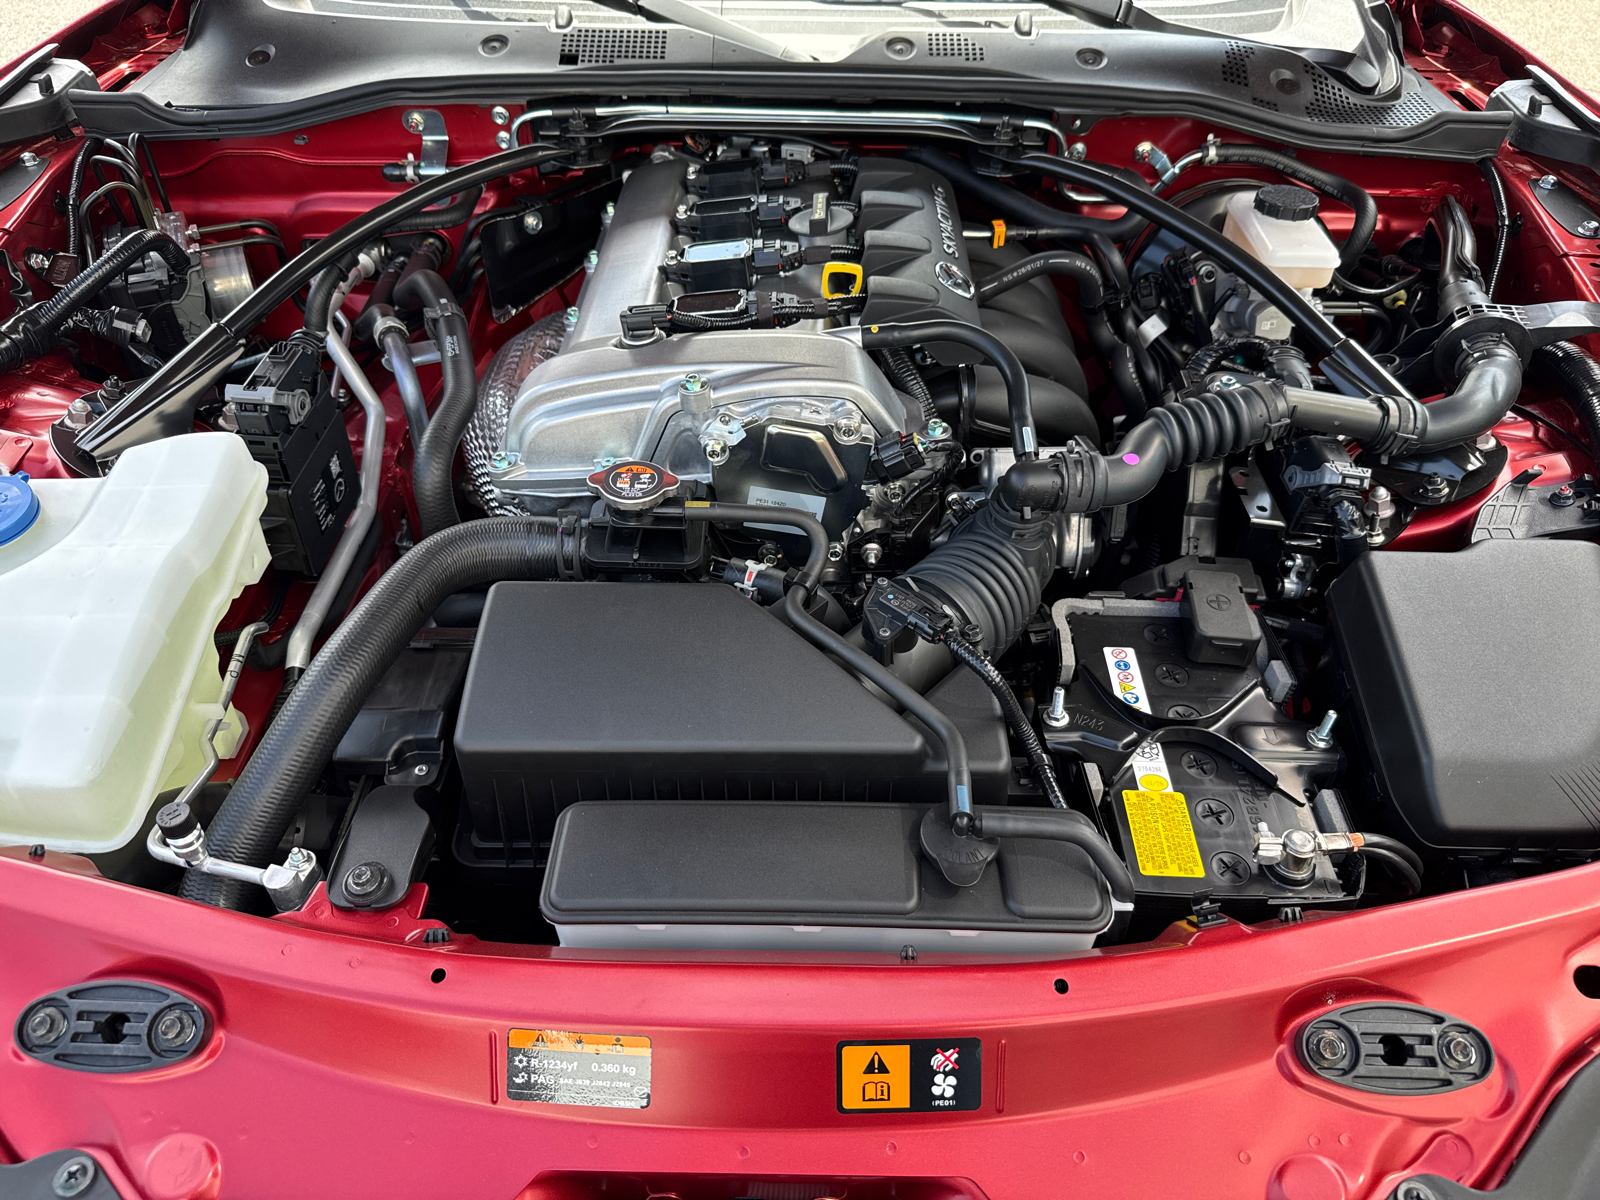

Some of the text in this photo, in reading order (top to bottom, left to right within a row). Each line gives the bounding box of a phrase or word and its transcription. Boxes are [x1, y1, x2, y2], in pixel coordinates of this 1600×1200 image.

[931, 183, 959, 259] SKYACTIV-G
[1147, 802, 1159, 823] POISON
[1177, 806, 1191, 831] DANGER
[530, 1057, 636, 1076] R-1234yf 0.360 kg
[530, 1074, 555, 1084] PAG
[931, 1099, 956, 1107] (PE01)
